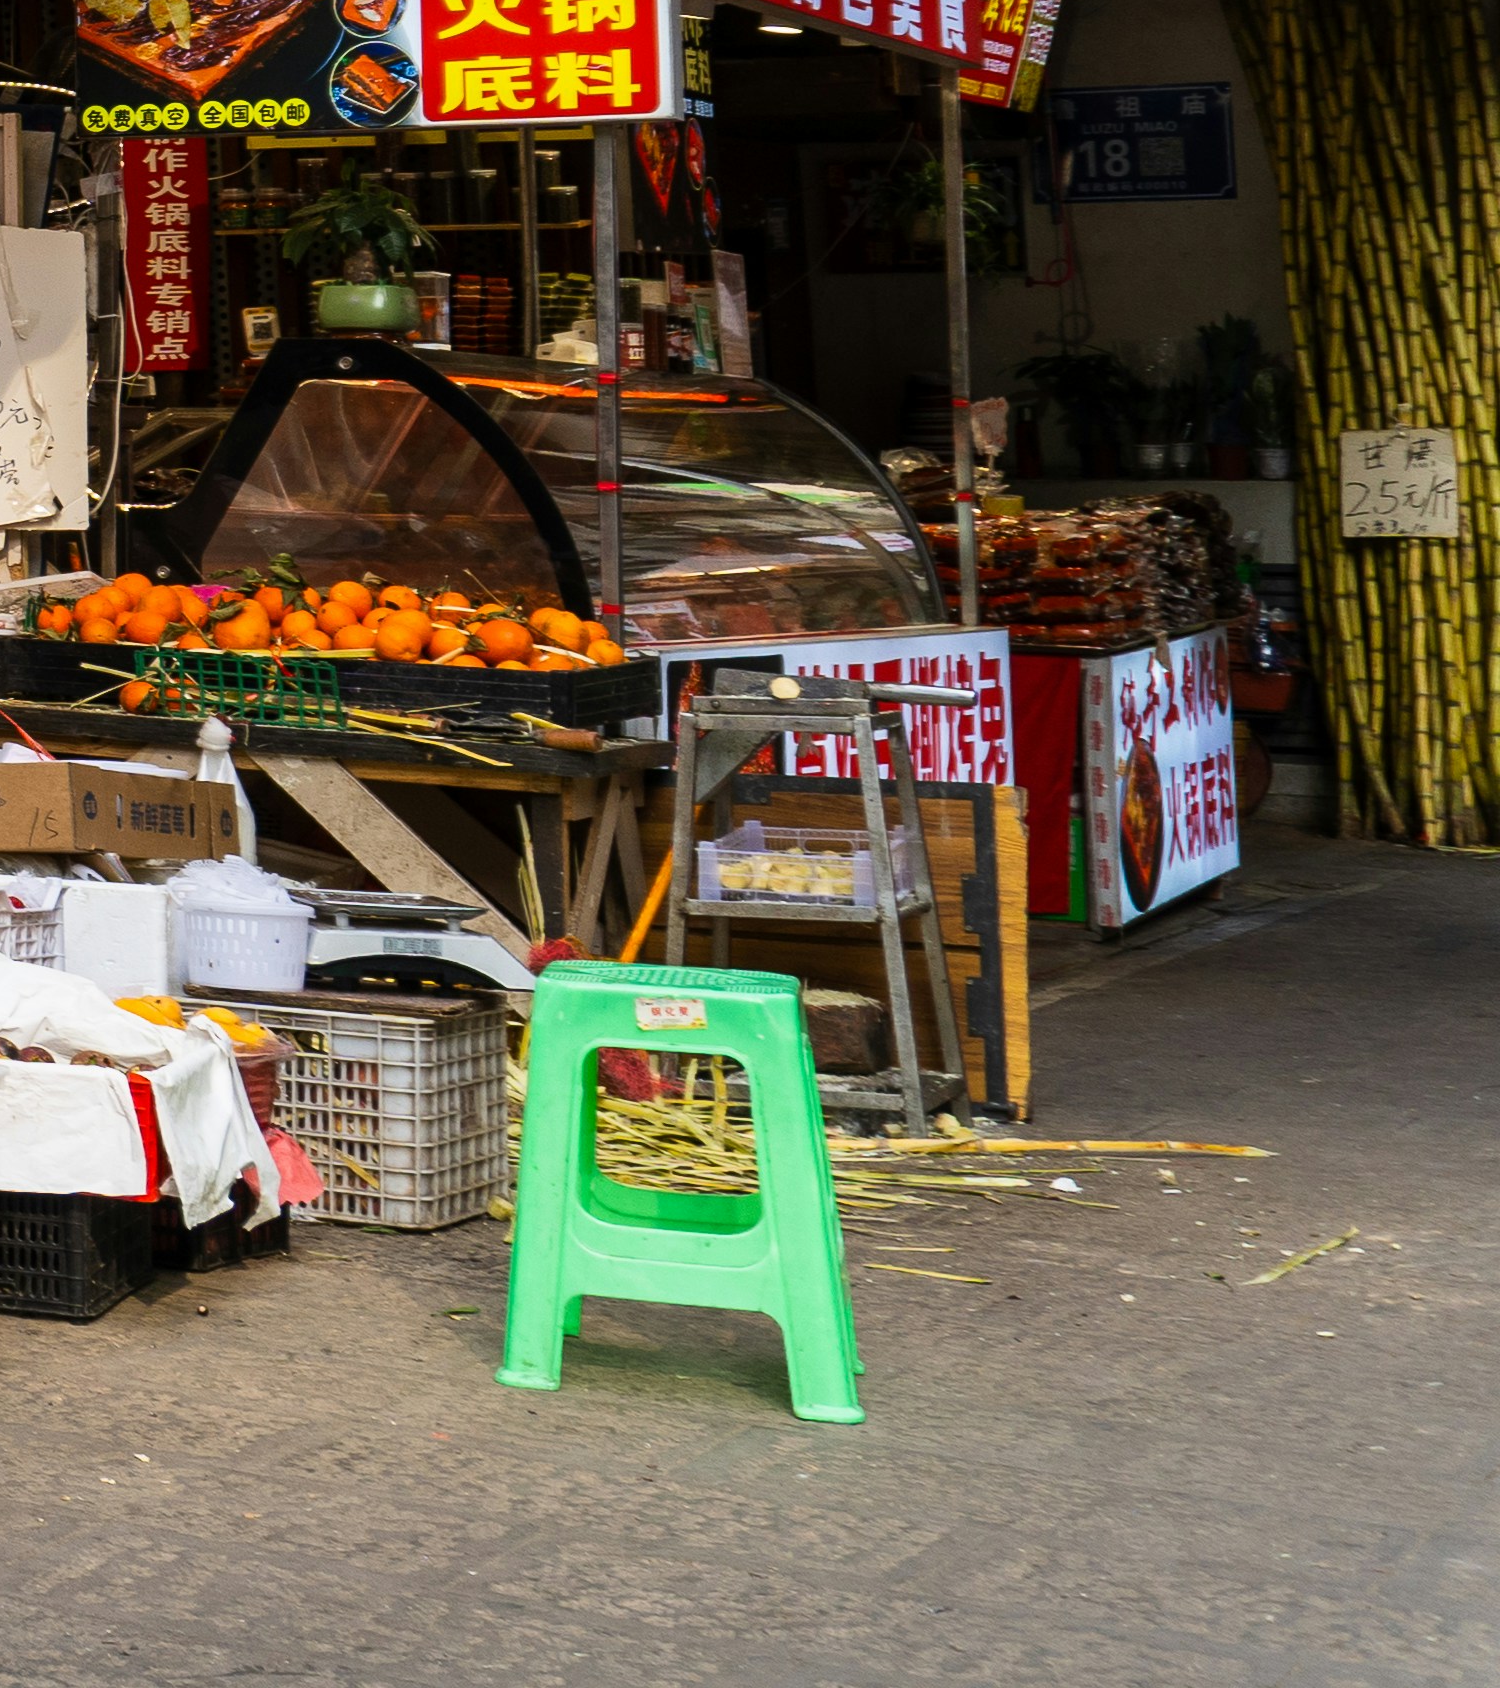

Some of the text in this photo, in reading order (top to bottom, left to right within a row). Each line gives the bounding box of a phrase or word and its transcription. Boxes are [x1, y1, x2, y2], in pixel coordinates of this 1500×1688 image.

[441, 47, 643, 114] 底料
[84, 101, 308, 131] 免费真空 全国包邮
[1077, 137, 1132, 179] 18
[129, 799, 187, 837] 新鲜蓝莓
